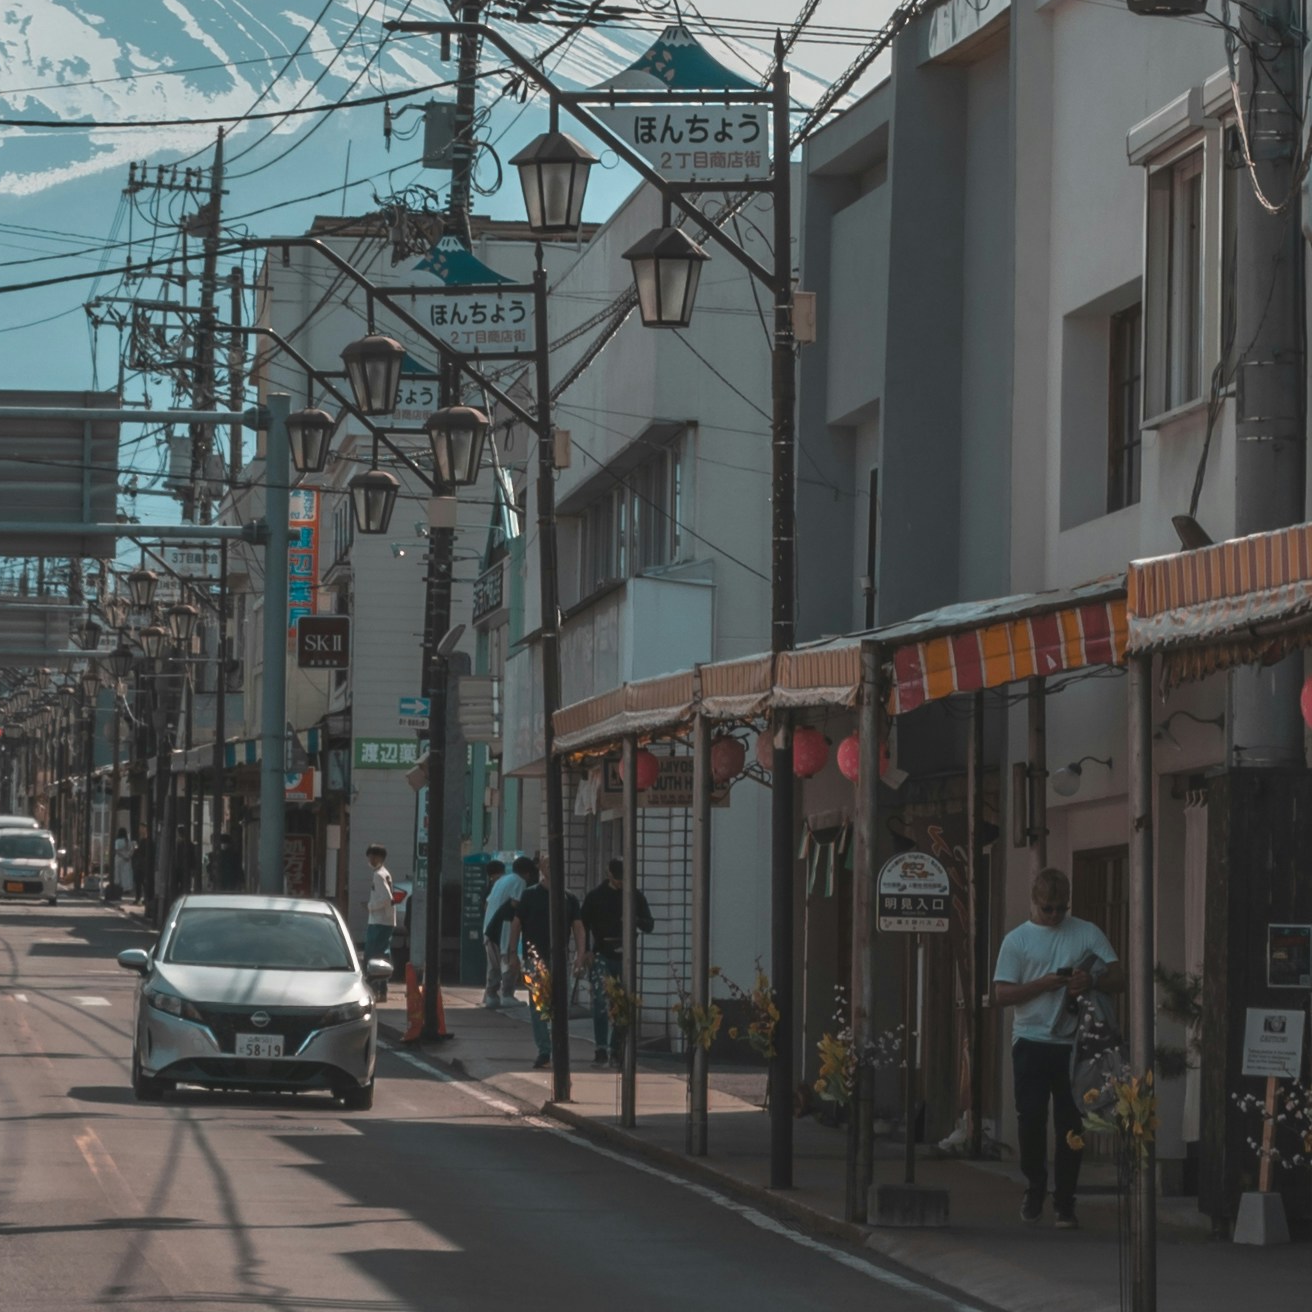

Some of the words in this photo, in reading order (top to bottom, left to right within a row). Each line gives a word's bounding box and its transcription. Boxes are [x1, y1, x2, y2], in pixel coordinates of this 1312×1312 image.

[634, 113, 761, 144] ほんちょう
[660, 150, 762, 169] 2丁目商店街
[430, 300, 526, 326] ほんちょう
[451, 328, 526, 345] 2丁目商店街
[884, 897, 945, 911] 明見入口
[246, 1043, 281, 1057] 58-19
